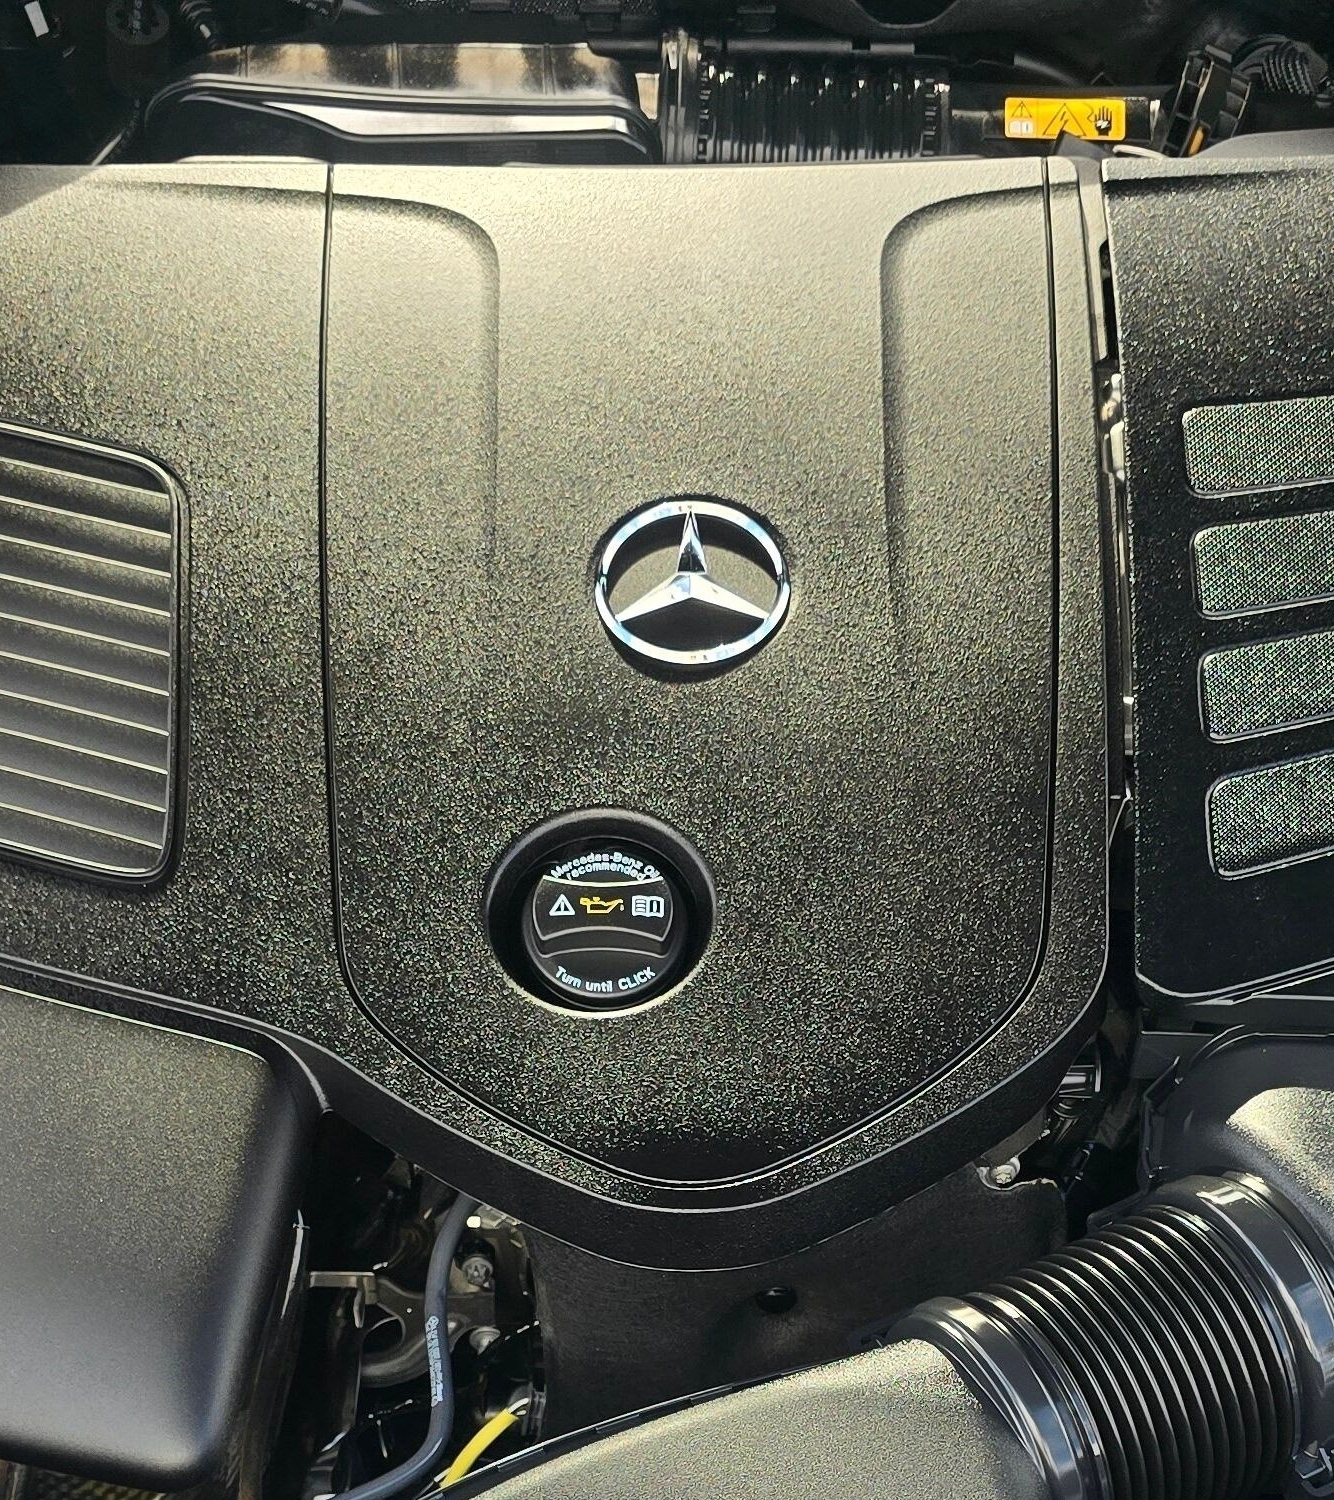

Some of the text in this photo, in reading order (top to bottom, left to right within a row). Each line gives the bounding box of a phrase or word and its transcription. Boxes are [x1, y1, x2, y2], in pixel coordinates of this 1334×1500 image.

[551, 852, 663, 880] Mercedes-Benz Oil
[566, 862, 648, 881] recommended
[555, 966, 656, 993] Turn until CLICK
